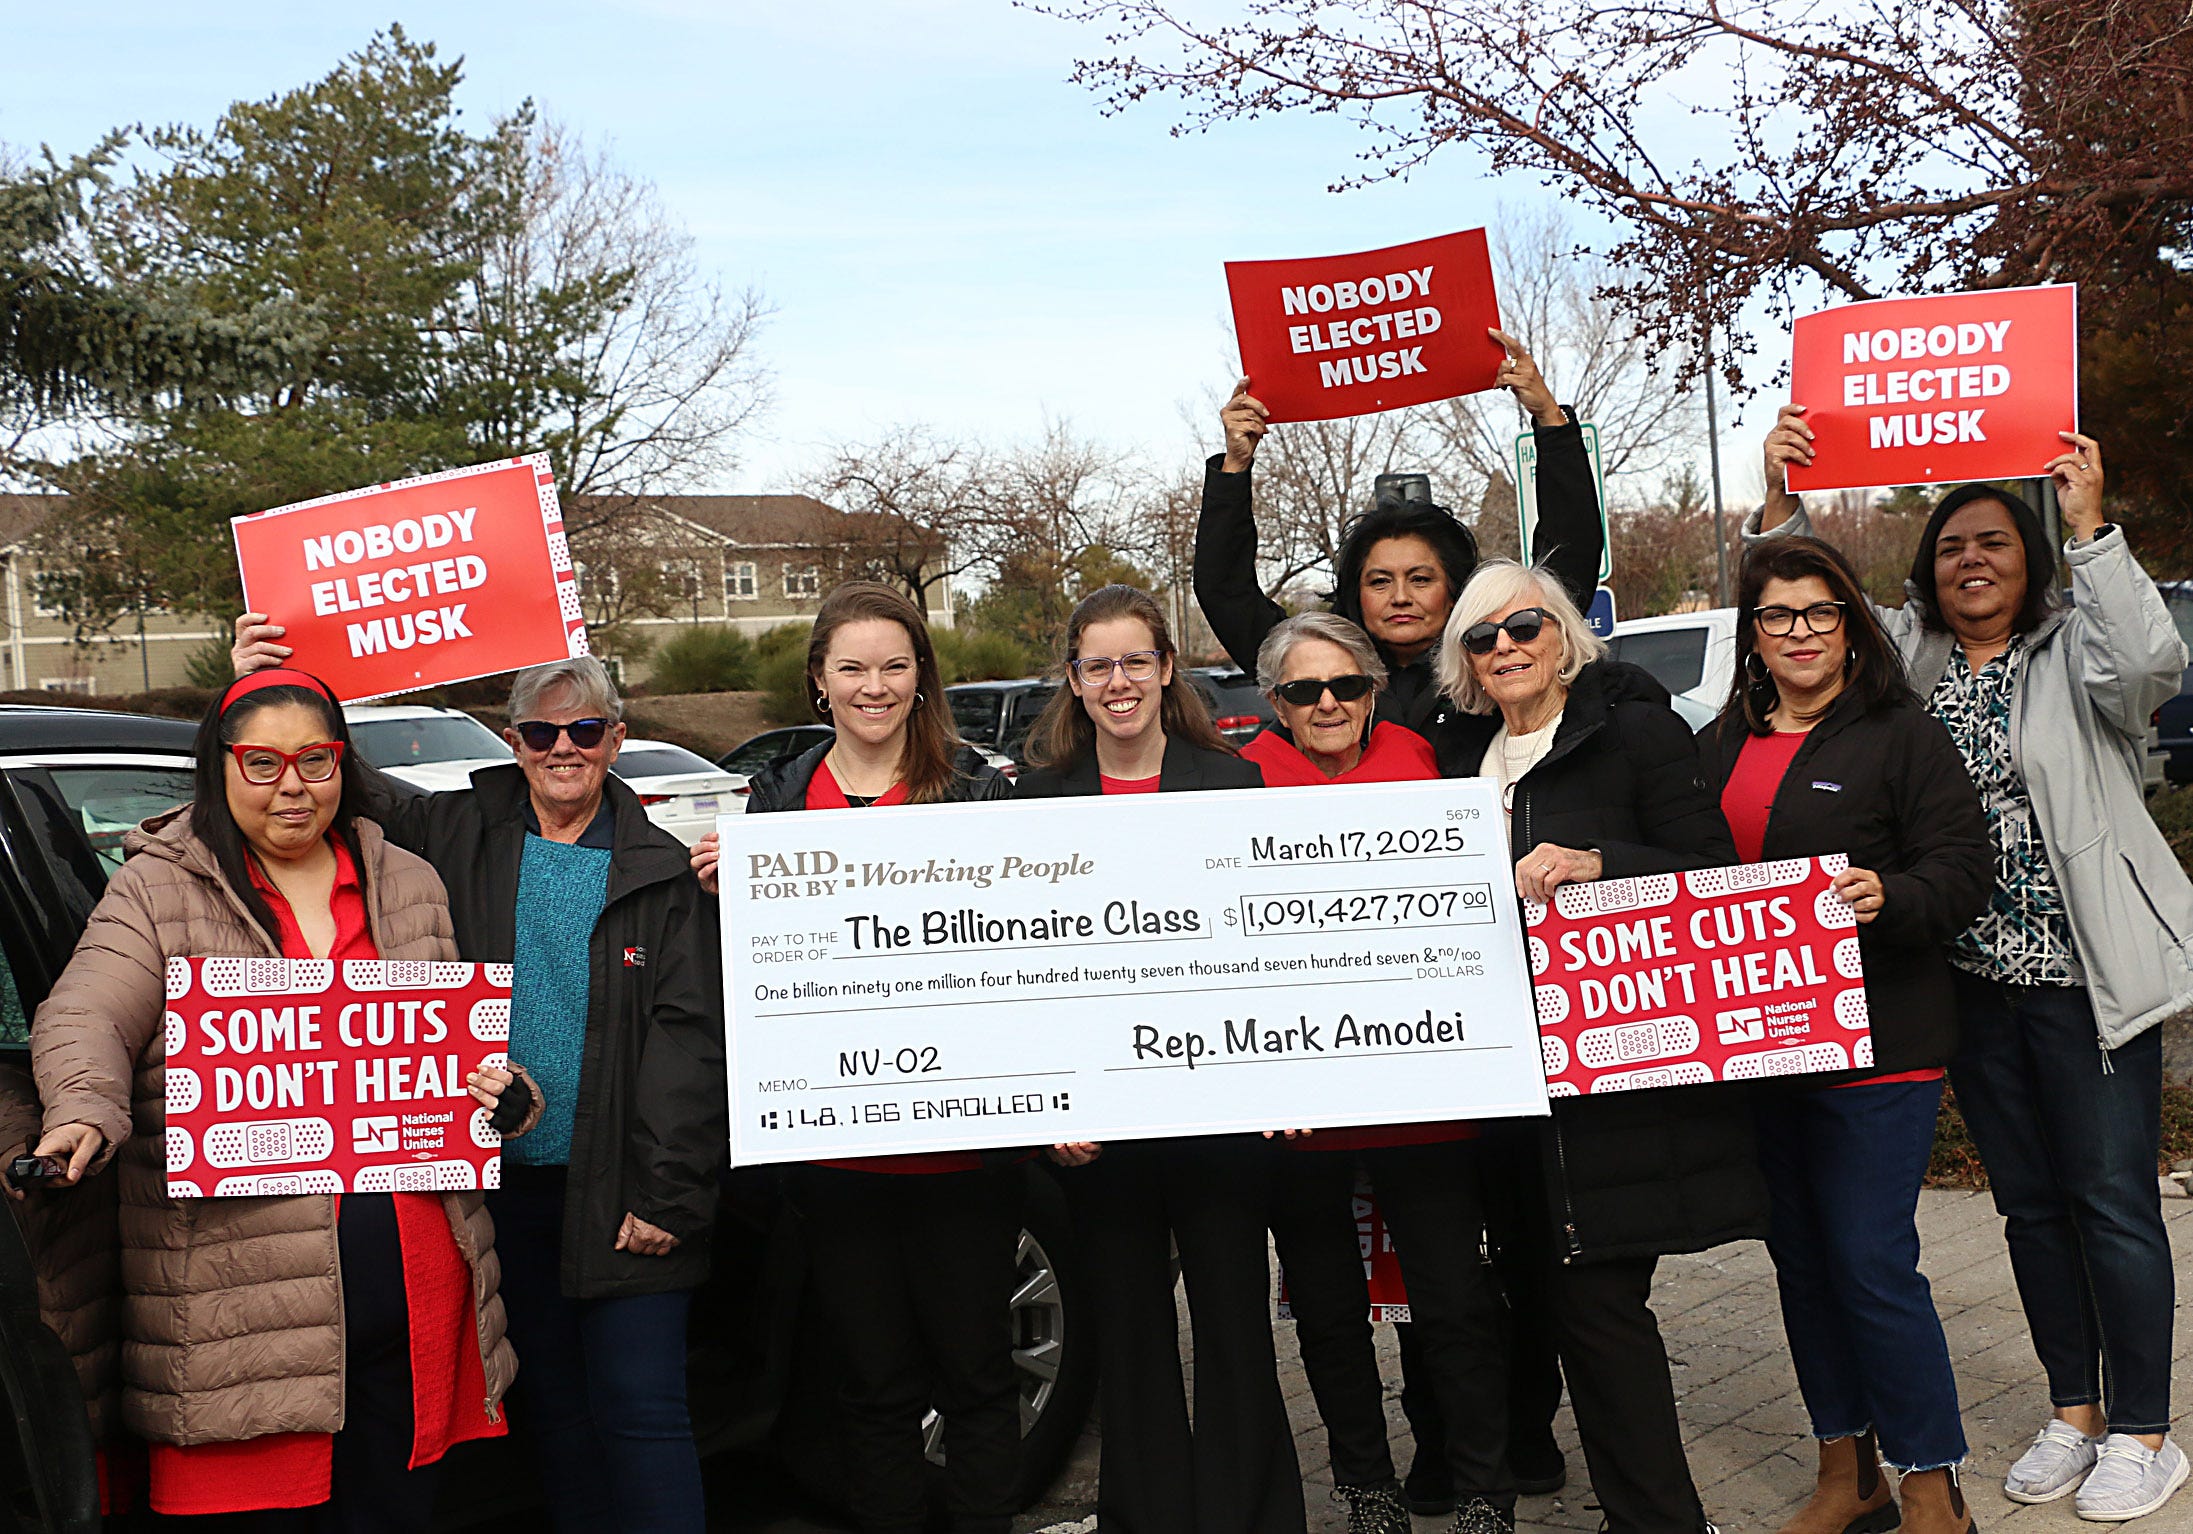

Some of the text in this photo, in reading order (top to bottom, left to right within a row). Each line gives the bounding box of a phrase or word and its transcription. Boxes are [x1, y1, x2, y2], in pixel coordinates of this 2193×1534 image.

[1282, 266, 1433, 315] NOBODY
[1289, 307, 1441, 353] ELECTED
[1844, 320, 2012, 364] NOBODY
[1320, 346, 1427, 387] MUSK
[1844, 365, 2010, 406] ELECTED
[1870, 409, 1986, 448] MUSK
[303, 507, 477, 571] NOBODY
[311, 555, 487, 616] ELECTED
[347, 604, 473, 657] MUSK
[1447, 809, 1479, 820] 5679
[748, 851, 838, 878] PAID
[1206, 828, 1463, 869] DATE March 17, 2025
[750, 880, 838, 899] FOR BY
[862, 859, 994, 888] Working
[1000, 853, 1094, 883] People
[752, 932, 838, 947] PAY TO THE
[845, 901, 1200, 949] The Billionaire Class
[1560, 897, 1796, 971] SOME CUTS
[753, 949, 827, 963] ORDER OF
[755, 985, 788, 1000] One
[794, 982, 837, 998] billion
[843, 981, 890, 997] ninety
[896, 981, 923, 992] one
[928, 974, 975, 989] million
[981, 972, 1012, 986] four
[1017, 967, 1078, 984] hundred
[1084, 967, 1135, 983] twenty
[1141, 967, 1184, 978] seven
[1189, 957, 1259, 975] thousand
[1265, 960, 1307, 971] seven
[1311, 951, 1371, 968] hundred
[1377, 954, 1419, 965] seven
[1417, 965, 1483, 978] DOLLARS
[1580, 945, 1826, 1019] DON'T HEAL
[1765, 998, 1817, 1016] National
[1767, 1013, 1810, 1027] Nurses
[200, 1000, 447, 1055] SOME CUTS
[1132, 1010, 1464, 1070] Rep. Mark Amodei
[1769, 1022, 1811, 1038] United
[840, 1047, 941, 1077] NV-02
[216, 1055, 467, 1112] DON'T HEAL
[759, 1079, 807, 1092] MEMO
[402, 1111, 454, 1126] National
[913, 1094, 1043, 1119] ENROLLED
[403, 1127, 445, 1138] Nurses
[403, 1137, 444, 1151] United
